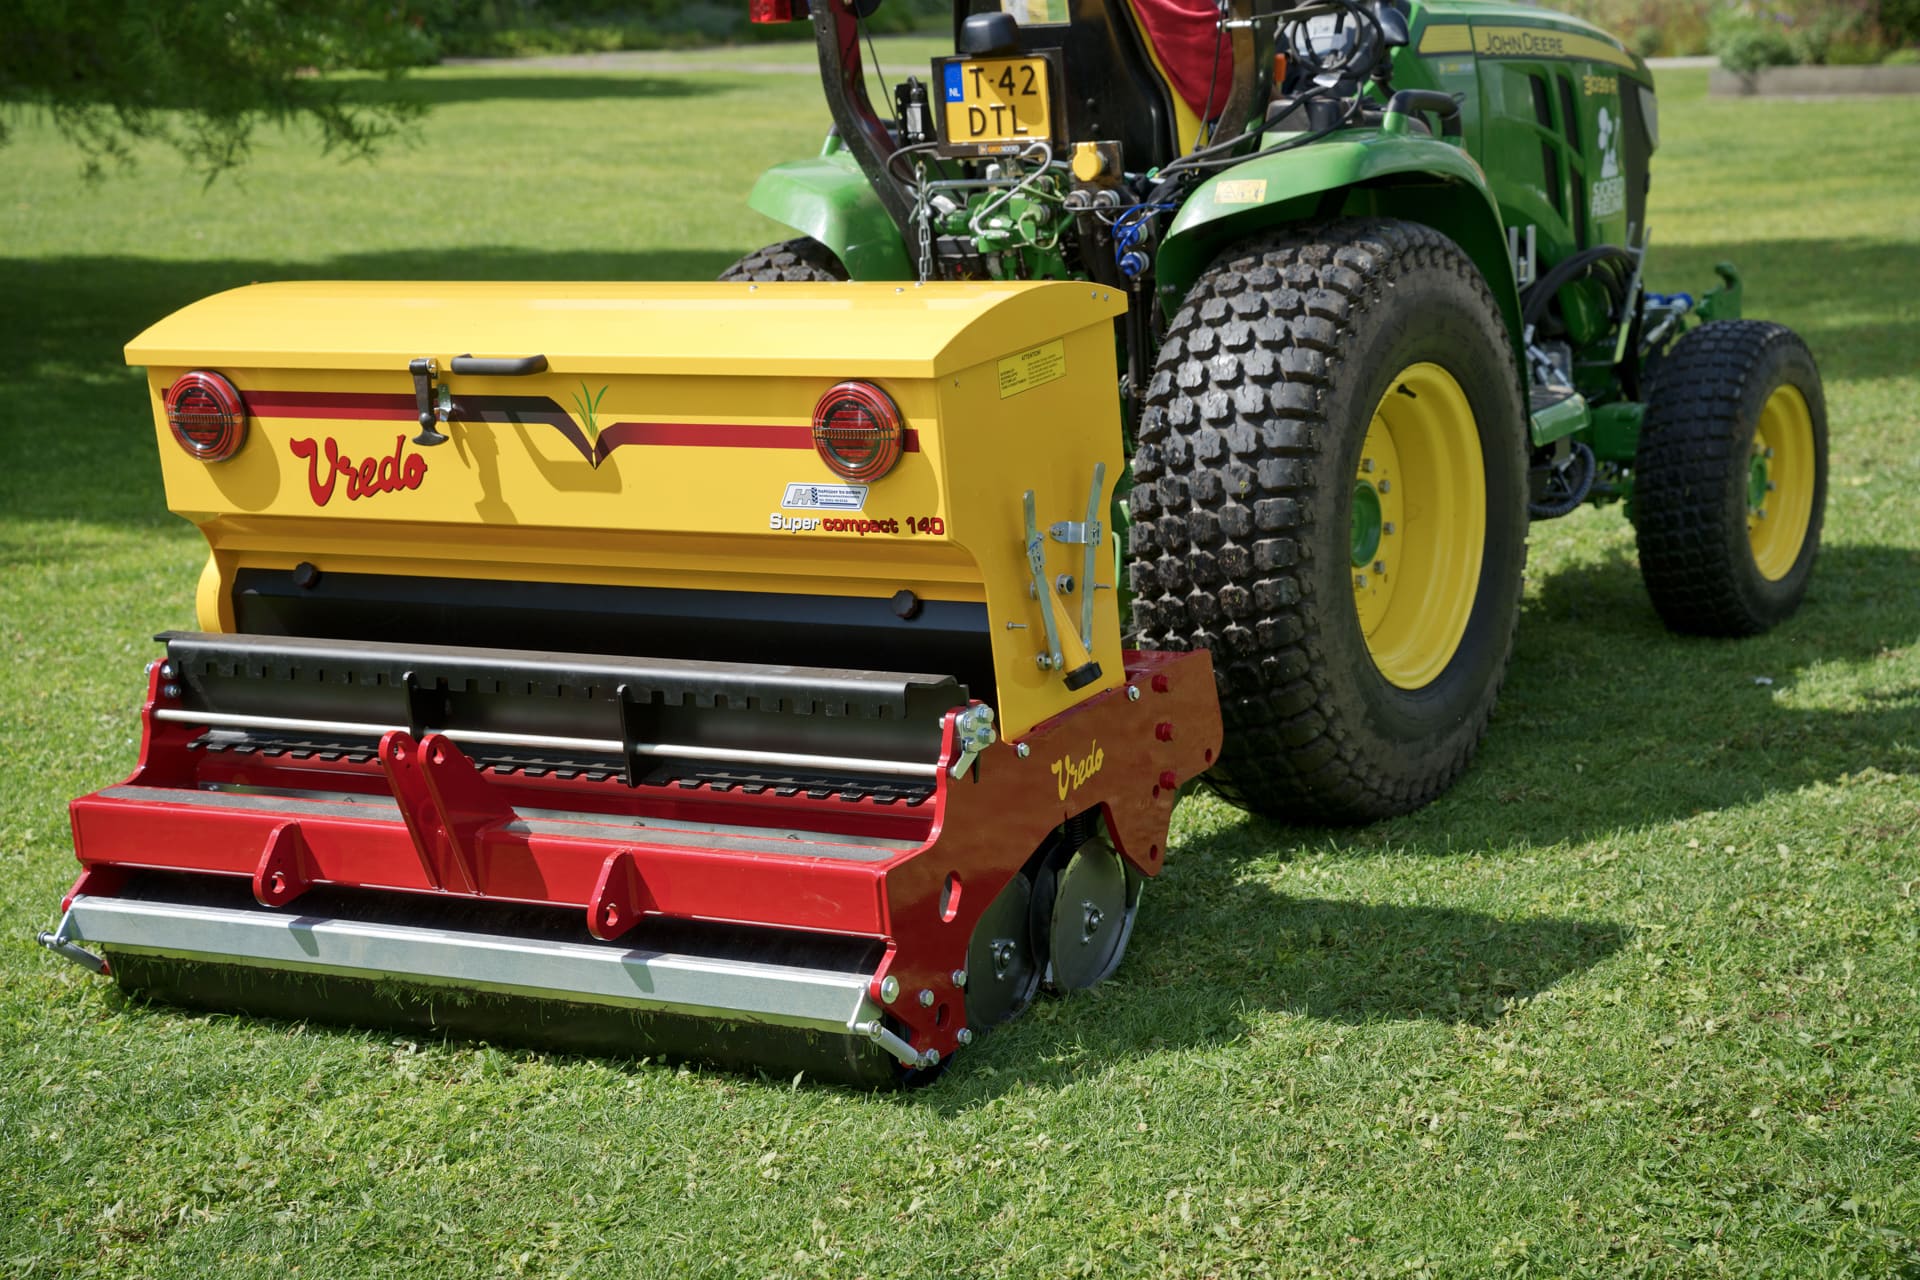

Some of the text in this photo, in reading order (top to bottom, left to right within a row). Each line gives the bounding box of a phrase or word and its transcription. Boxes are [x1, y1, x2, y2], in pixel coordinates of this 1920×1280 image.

[1485, 32, 1564, 53] JOHN DEERE
[949, 87, 960, 97] NL
[969, 64, 1037, 98] T-42
[968, 105, 1028, 137] DTL
[289, 434, 428, 507] Vredo
[769, 513, 945, 536] Super compact 140
[1051, 739, 1104, 801] Vredo
